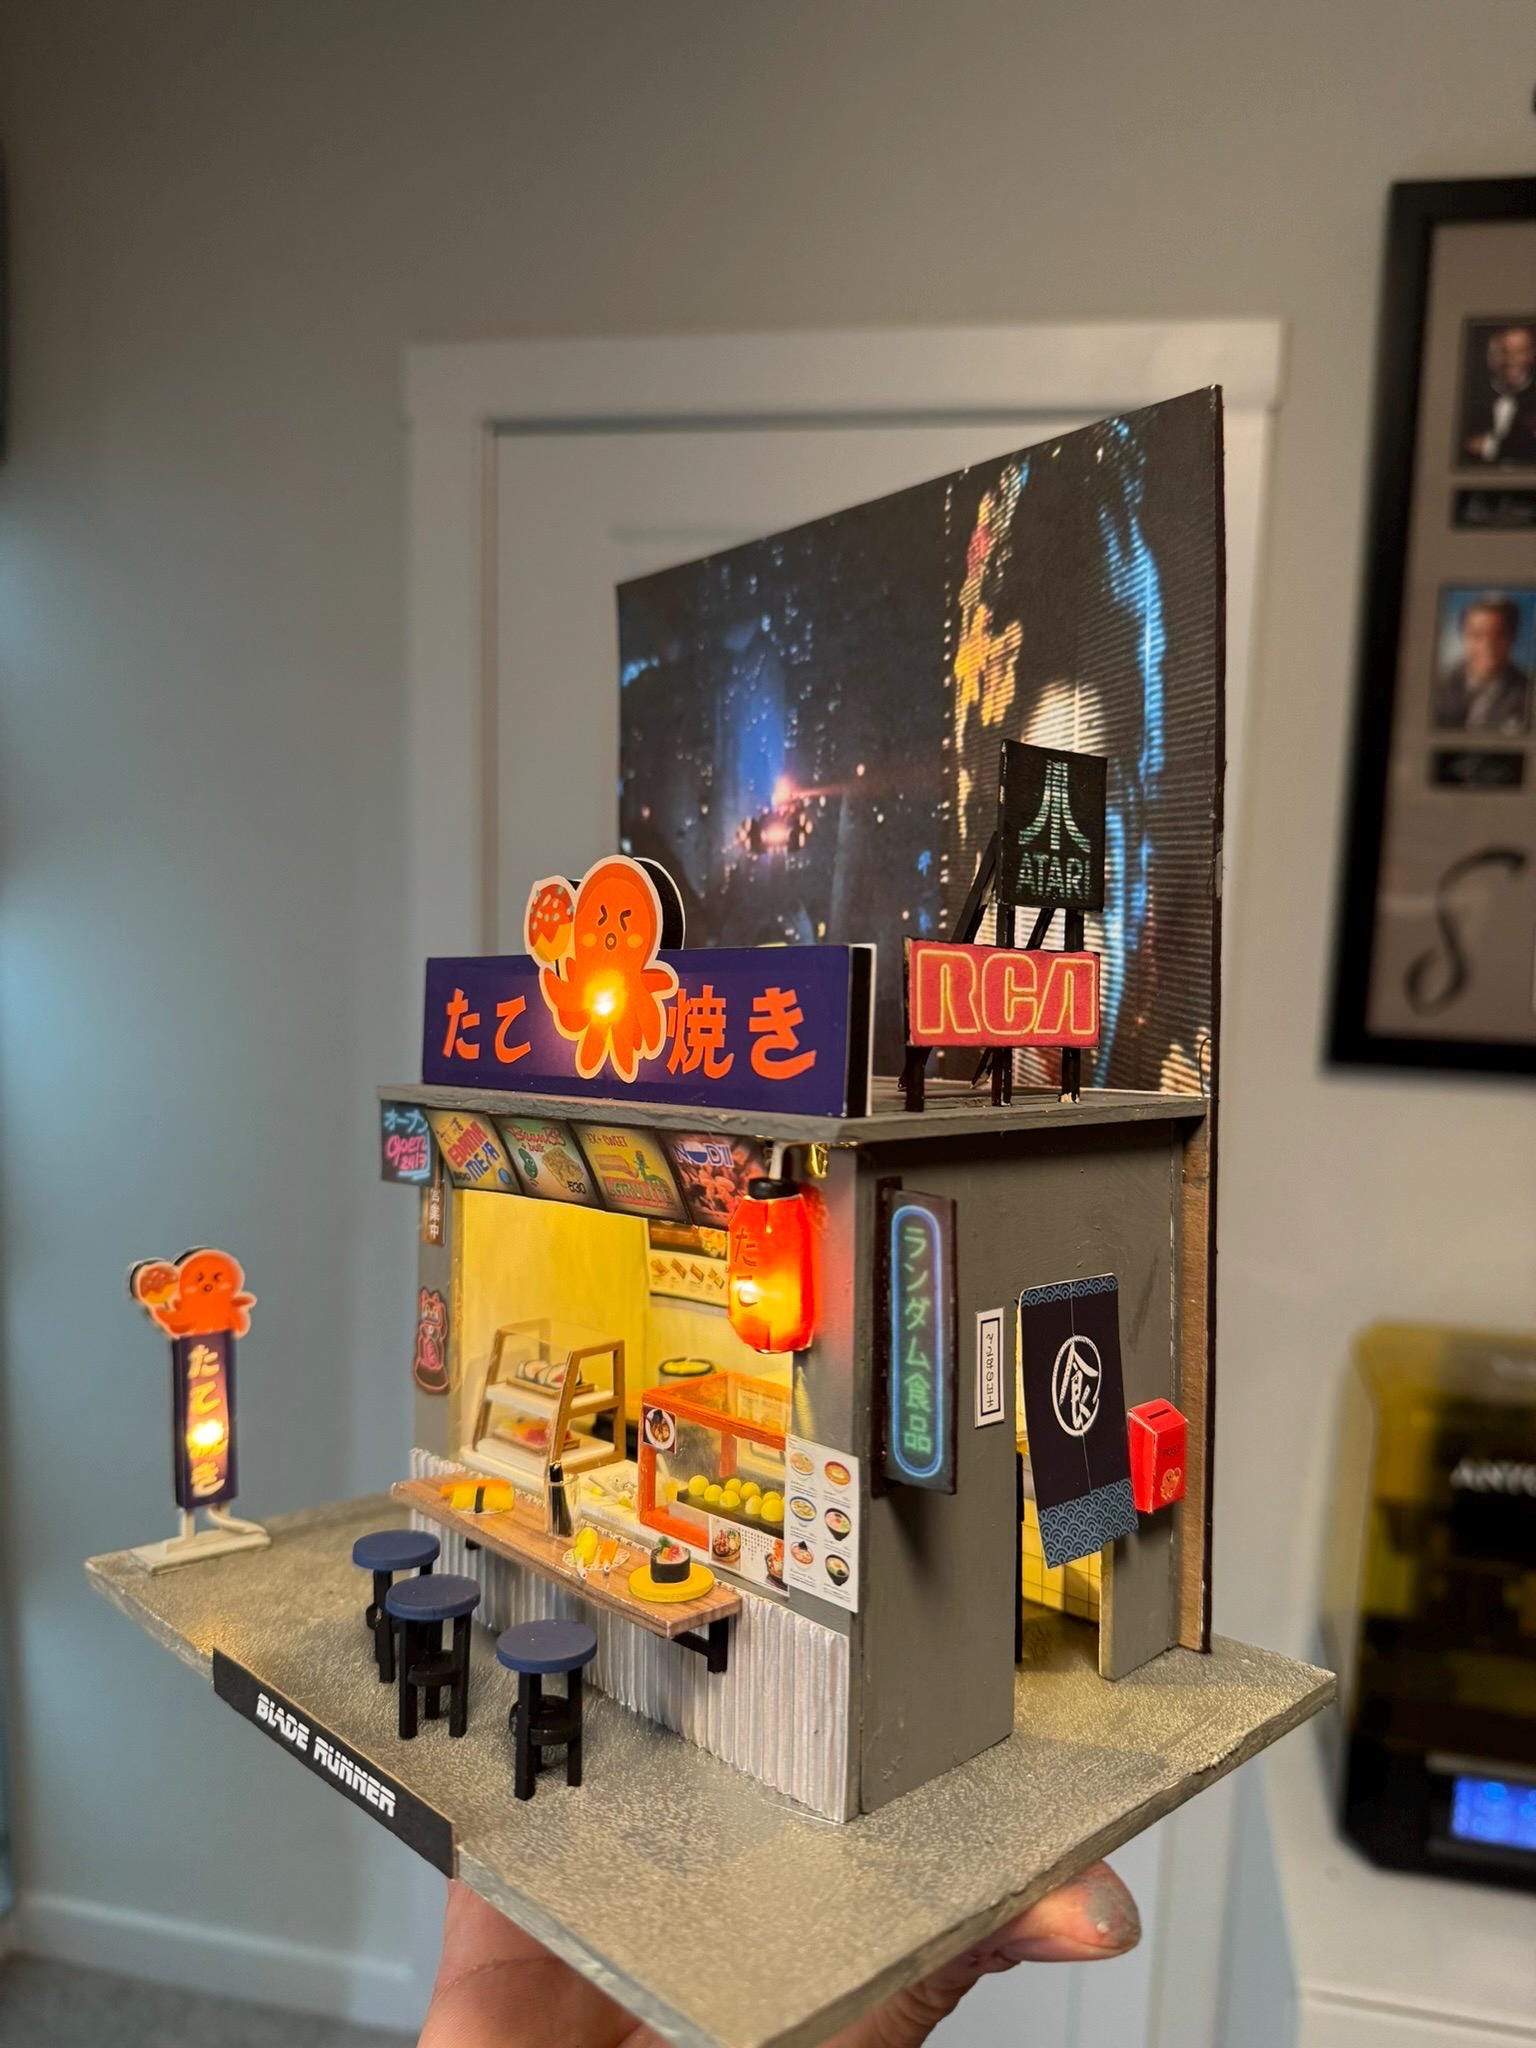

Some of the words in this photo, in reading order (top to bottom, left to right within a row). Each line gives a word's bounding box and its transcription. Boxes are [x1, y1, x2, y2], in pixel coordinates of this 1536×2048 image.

[1015, 852, 1092, 899] ATARI
[916, 949, 1096, 1035] RCA
[256, 1692, 310, 1751] BLADE
[313, 1735, 397, 1818] RUNNER
